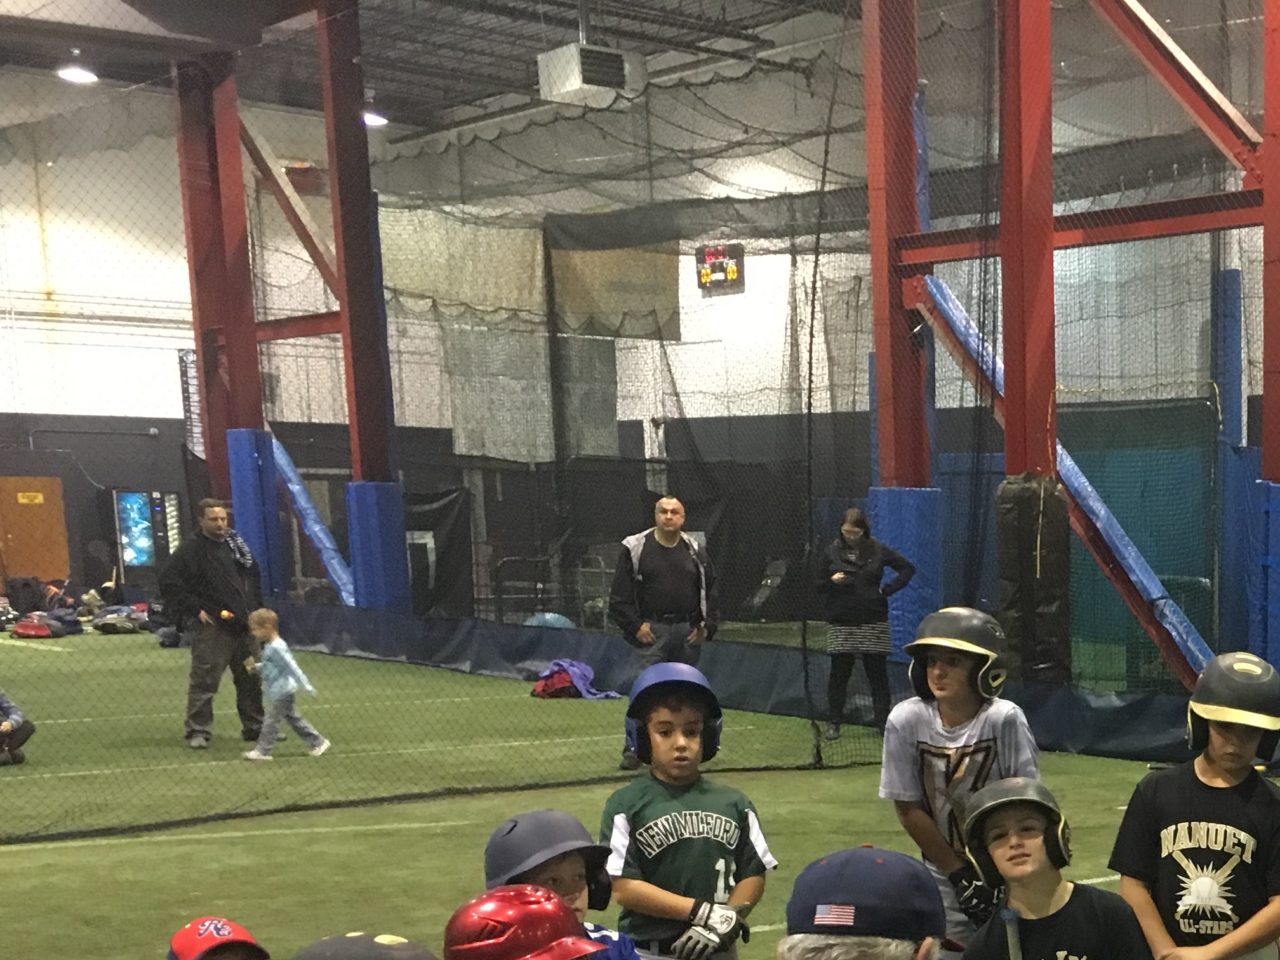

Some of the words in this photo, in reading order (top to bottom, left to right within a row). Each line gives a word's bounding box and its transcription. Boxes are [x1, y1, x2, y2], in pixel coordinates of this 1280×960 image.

[635, 815, 678, 859] NEW
[672, 810, 741, 850] MILFORD
[1160, 821, 1257, 865] NANUET
